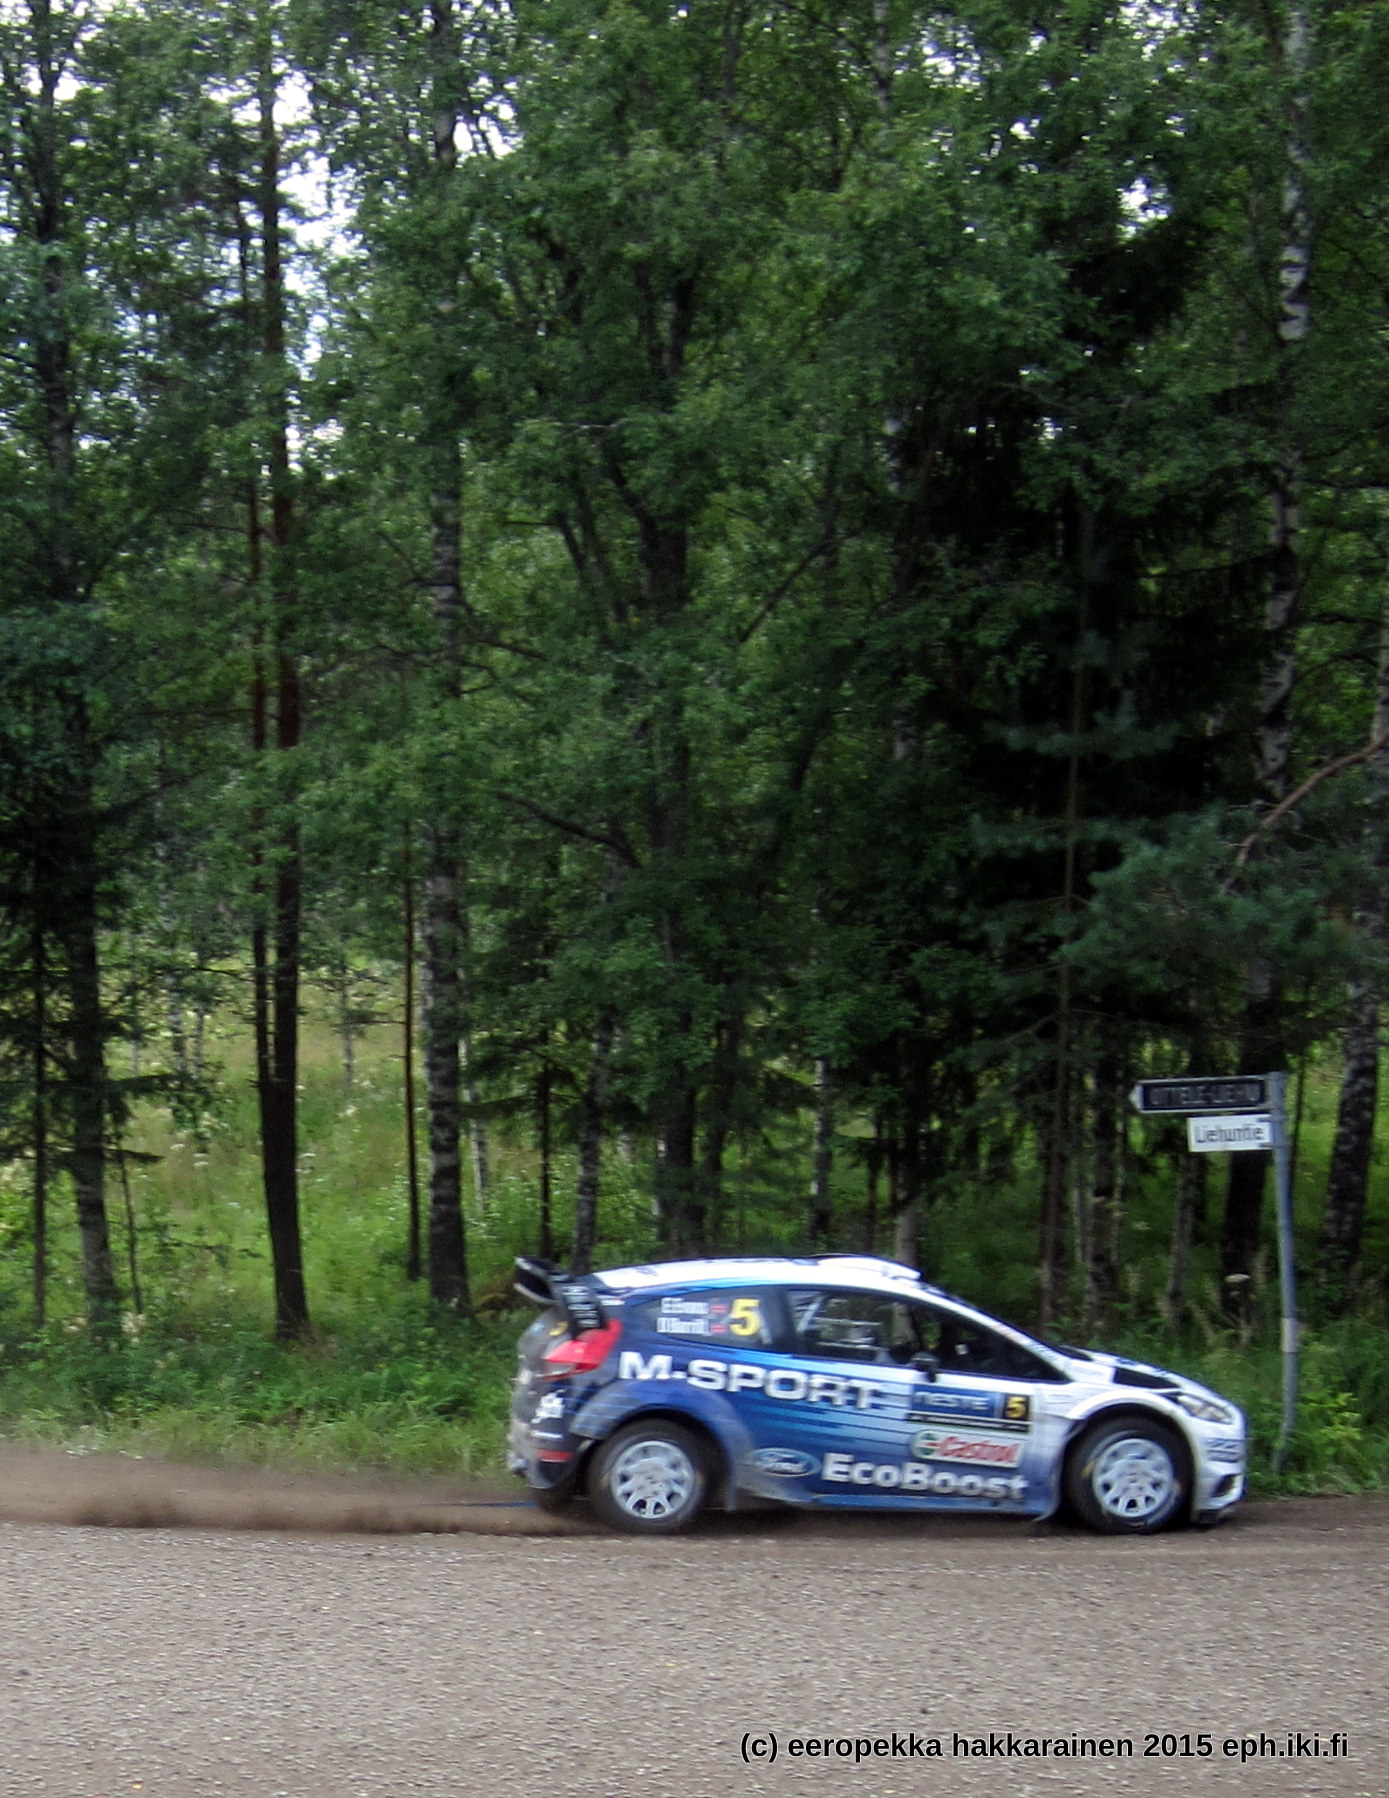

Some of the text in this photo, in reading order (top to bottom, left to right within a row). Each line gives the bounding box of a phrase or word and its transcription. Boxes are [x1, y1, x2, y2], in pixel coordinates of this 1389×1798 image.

[729, 1298, 761, 1336] 5
[1004, 1396, 1028, 1418] 5
[821, 1452, 1030, 1499] EcoBoost
